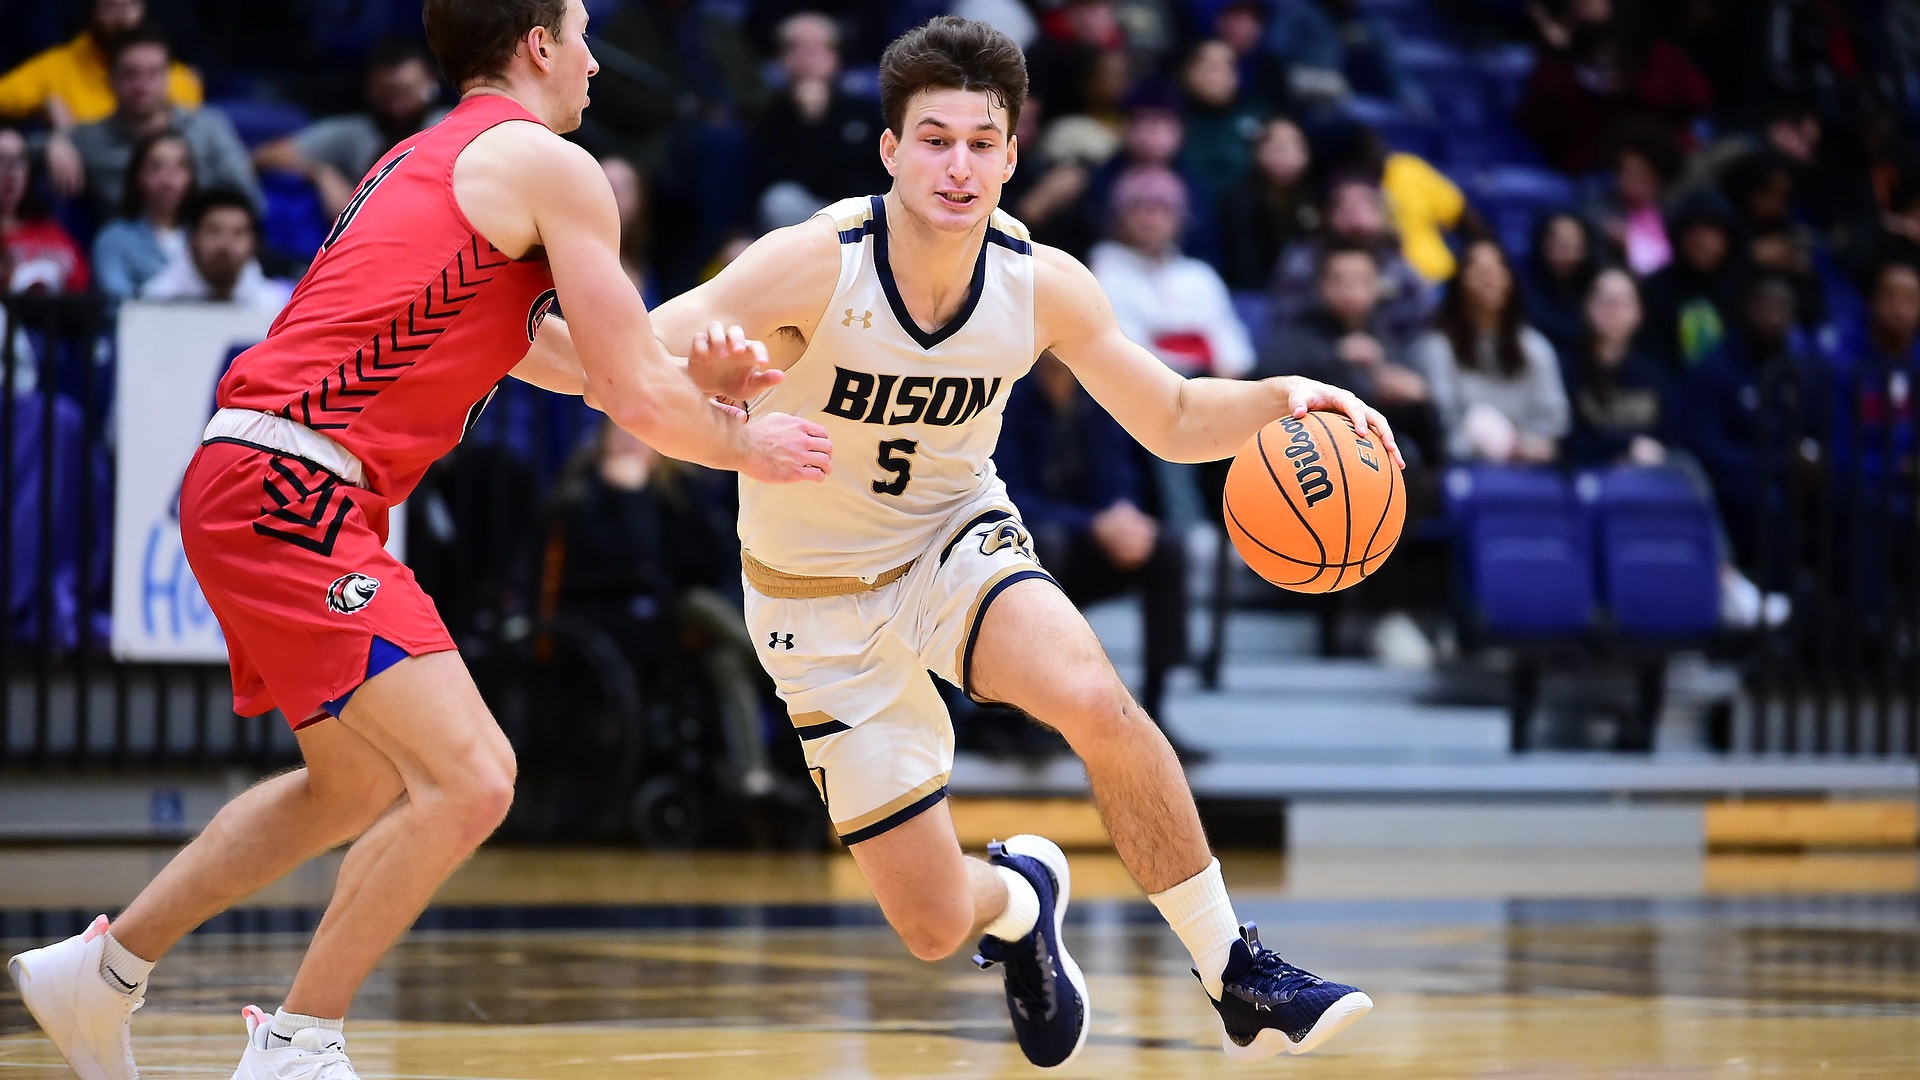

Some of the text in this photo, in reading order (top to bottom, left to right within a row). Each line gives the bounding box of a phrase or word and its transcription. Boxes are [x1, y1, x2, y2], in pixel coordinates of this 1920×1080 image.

[821, 365, 1002, 426] BISON
[871, 438, 919, 496] 5
[1279, 415, 1334, 508] Wilson
